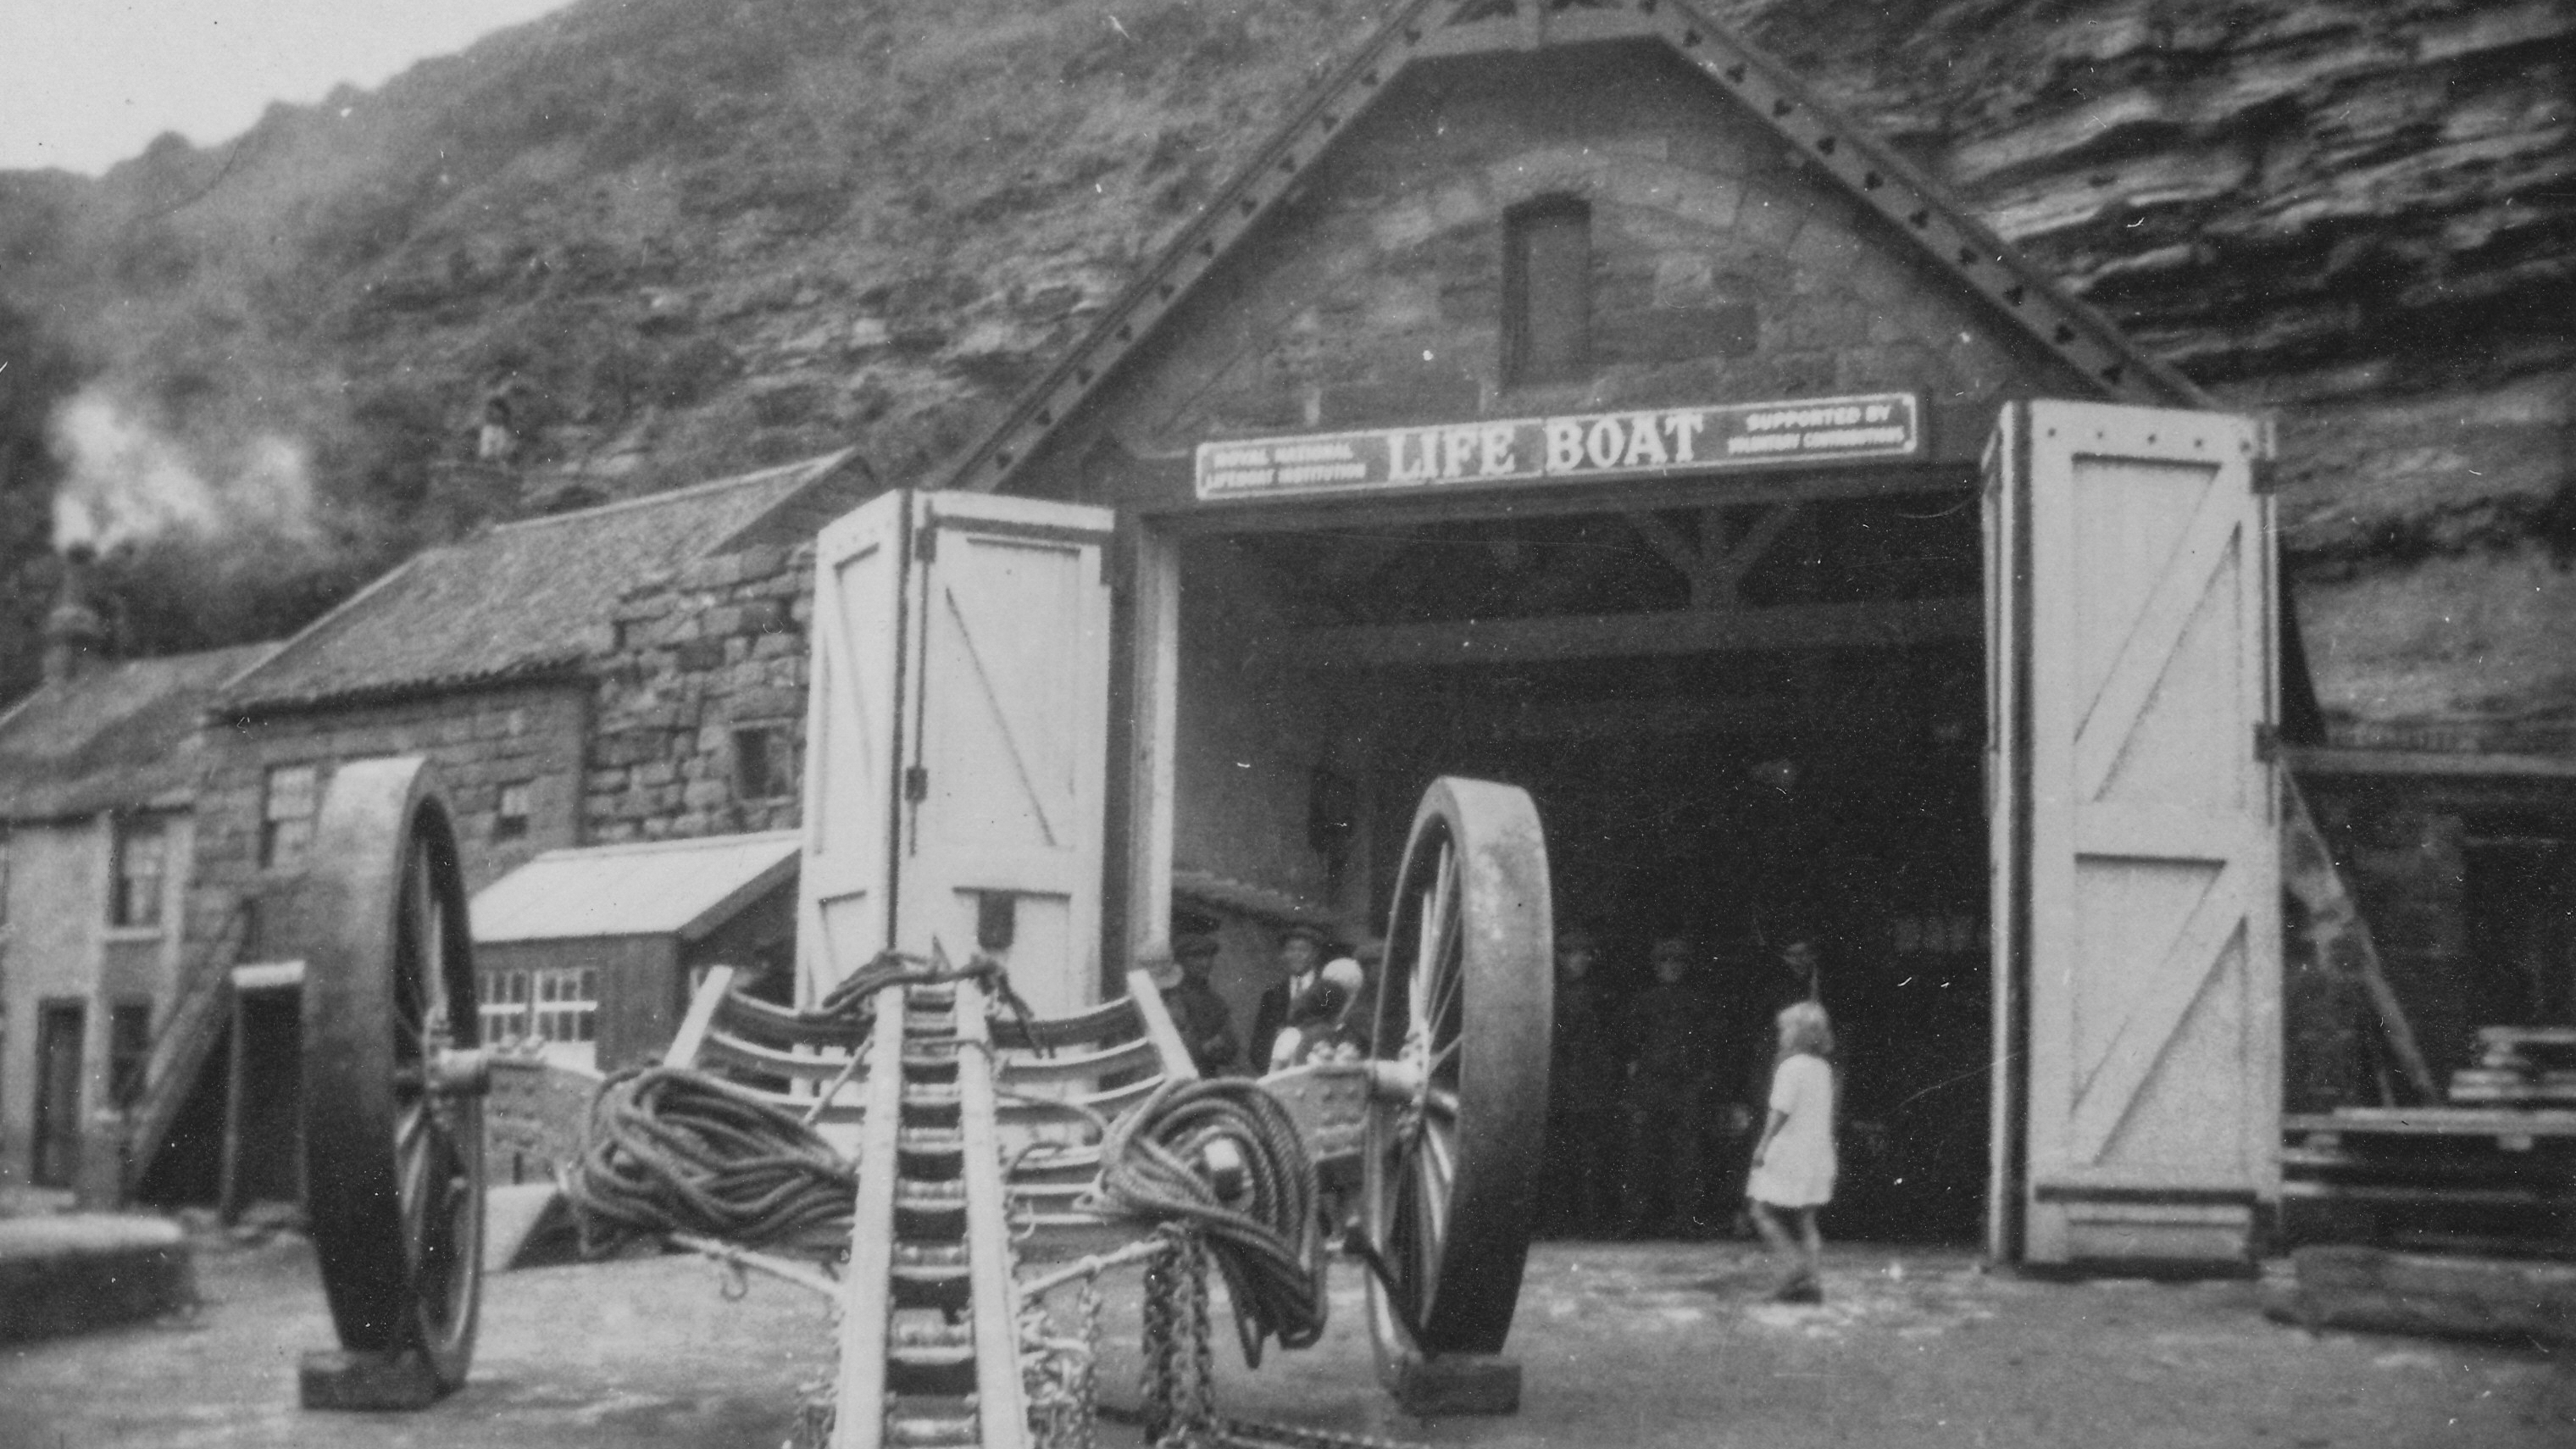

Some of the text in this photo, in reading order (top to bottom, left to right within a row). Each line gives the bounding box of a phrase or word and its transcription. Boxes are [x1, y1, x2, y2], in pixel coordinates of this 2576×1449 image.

[1746, 405, 1891, 432] SUPPORTED BY
[1213, 443, 1354, 467] ROYAL NATIONAL
[1387, 414, 1703, 482] LIFE BOAT
